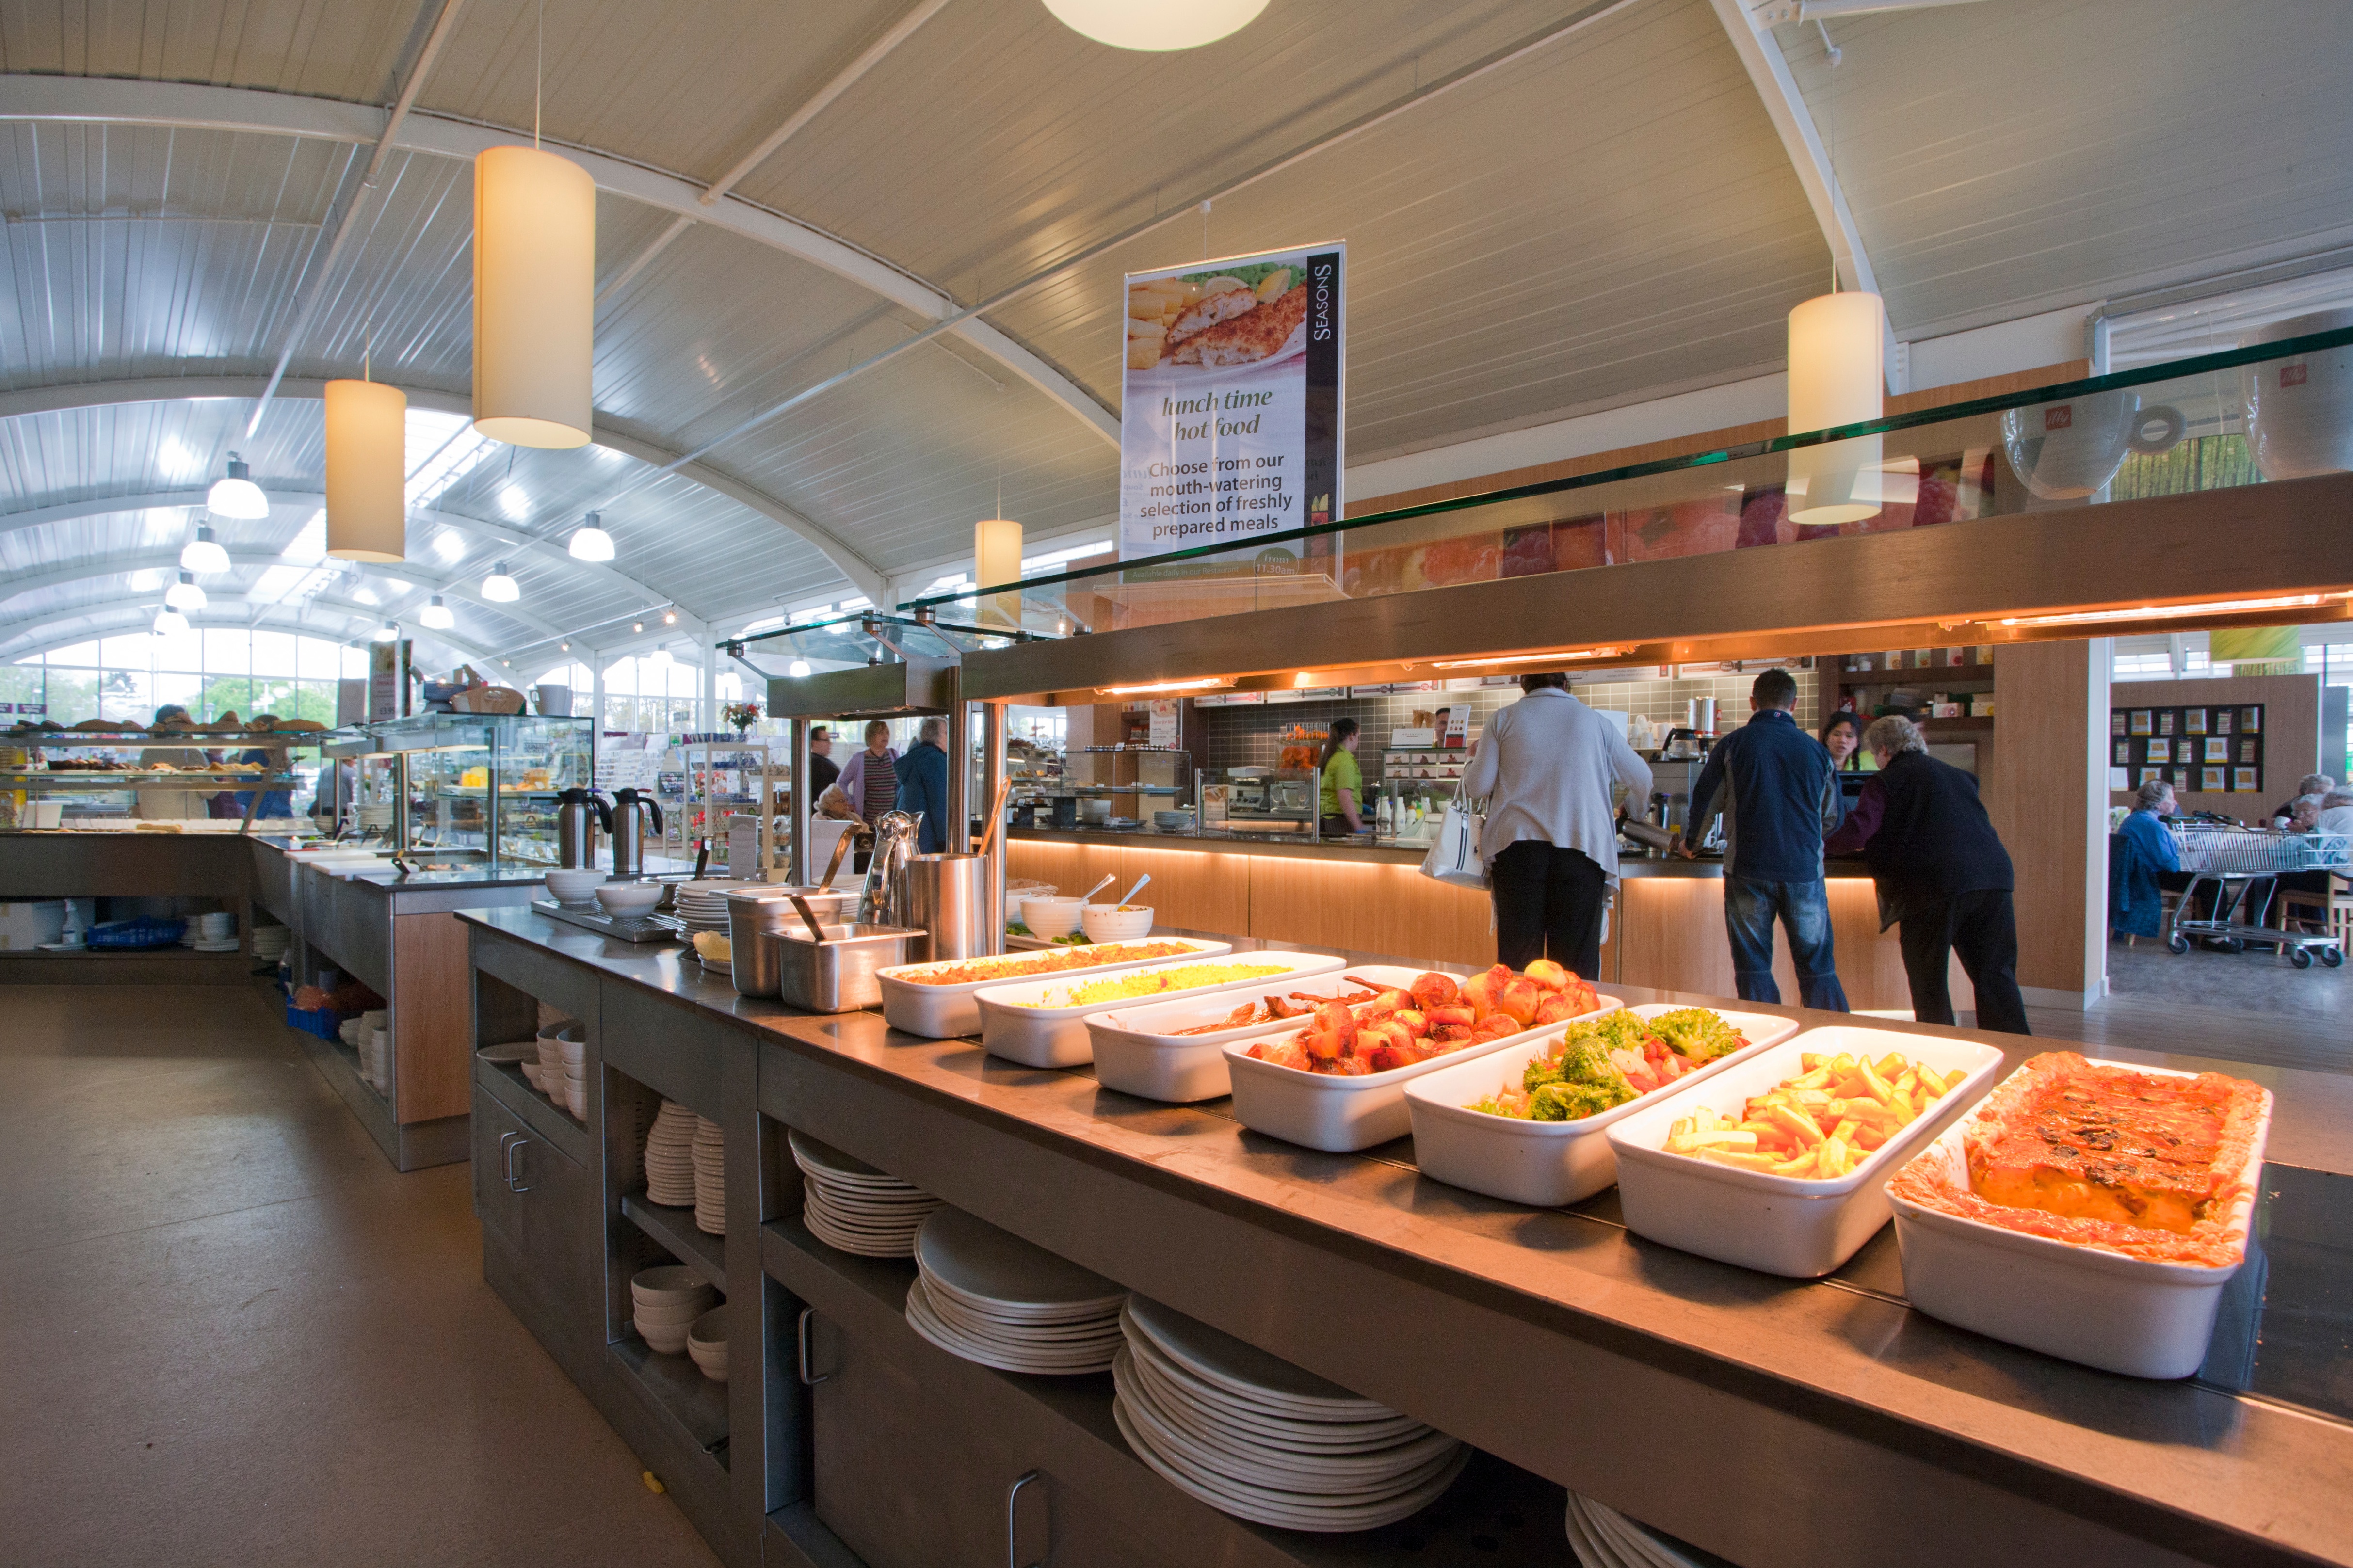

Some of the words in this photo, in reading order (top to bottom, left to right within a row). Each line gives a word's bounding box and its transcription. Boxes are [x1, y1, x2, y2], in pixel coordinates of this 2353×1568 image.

[1313, 264, 1332, 341] SEASONS
[1162, 392, 1219, 416] lunch
[1224, 390, 1273, 410] time
[1174, 421, 1210, 441] hot
[1212, 414, 1261, 441] food
[1149, 462, 1208, 477] Choose
[1212, 457, 1250, 472] from
[1256, 455, 1284, 468] our
[1150, 474, 1282, 497] mouth-watering
[1141, 500, 1210, 517] selection
[1216, 496, 1233, 512] of
[1236, 493, 1292, 511] freshly
[1153, 517, 1225, 540] prepared
[1230, 514, 1278, 531] meals
[1256, 563, 1295, 575] 11.30am
[1264, 554, 1289, 564] from
[1132, 570, 1163, 578] Available
[1163, 569, 1180, 577] daily
[1203, 566, 1239, 575] Restaurant
